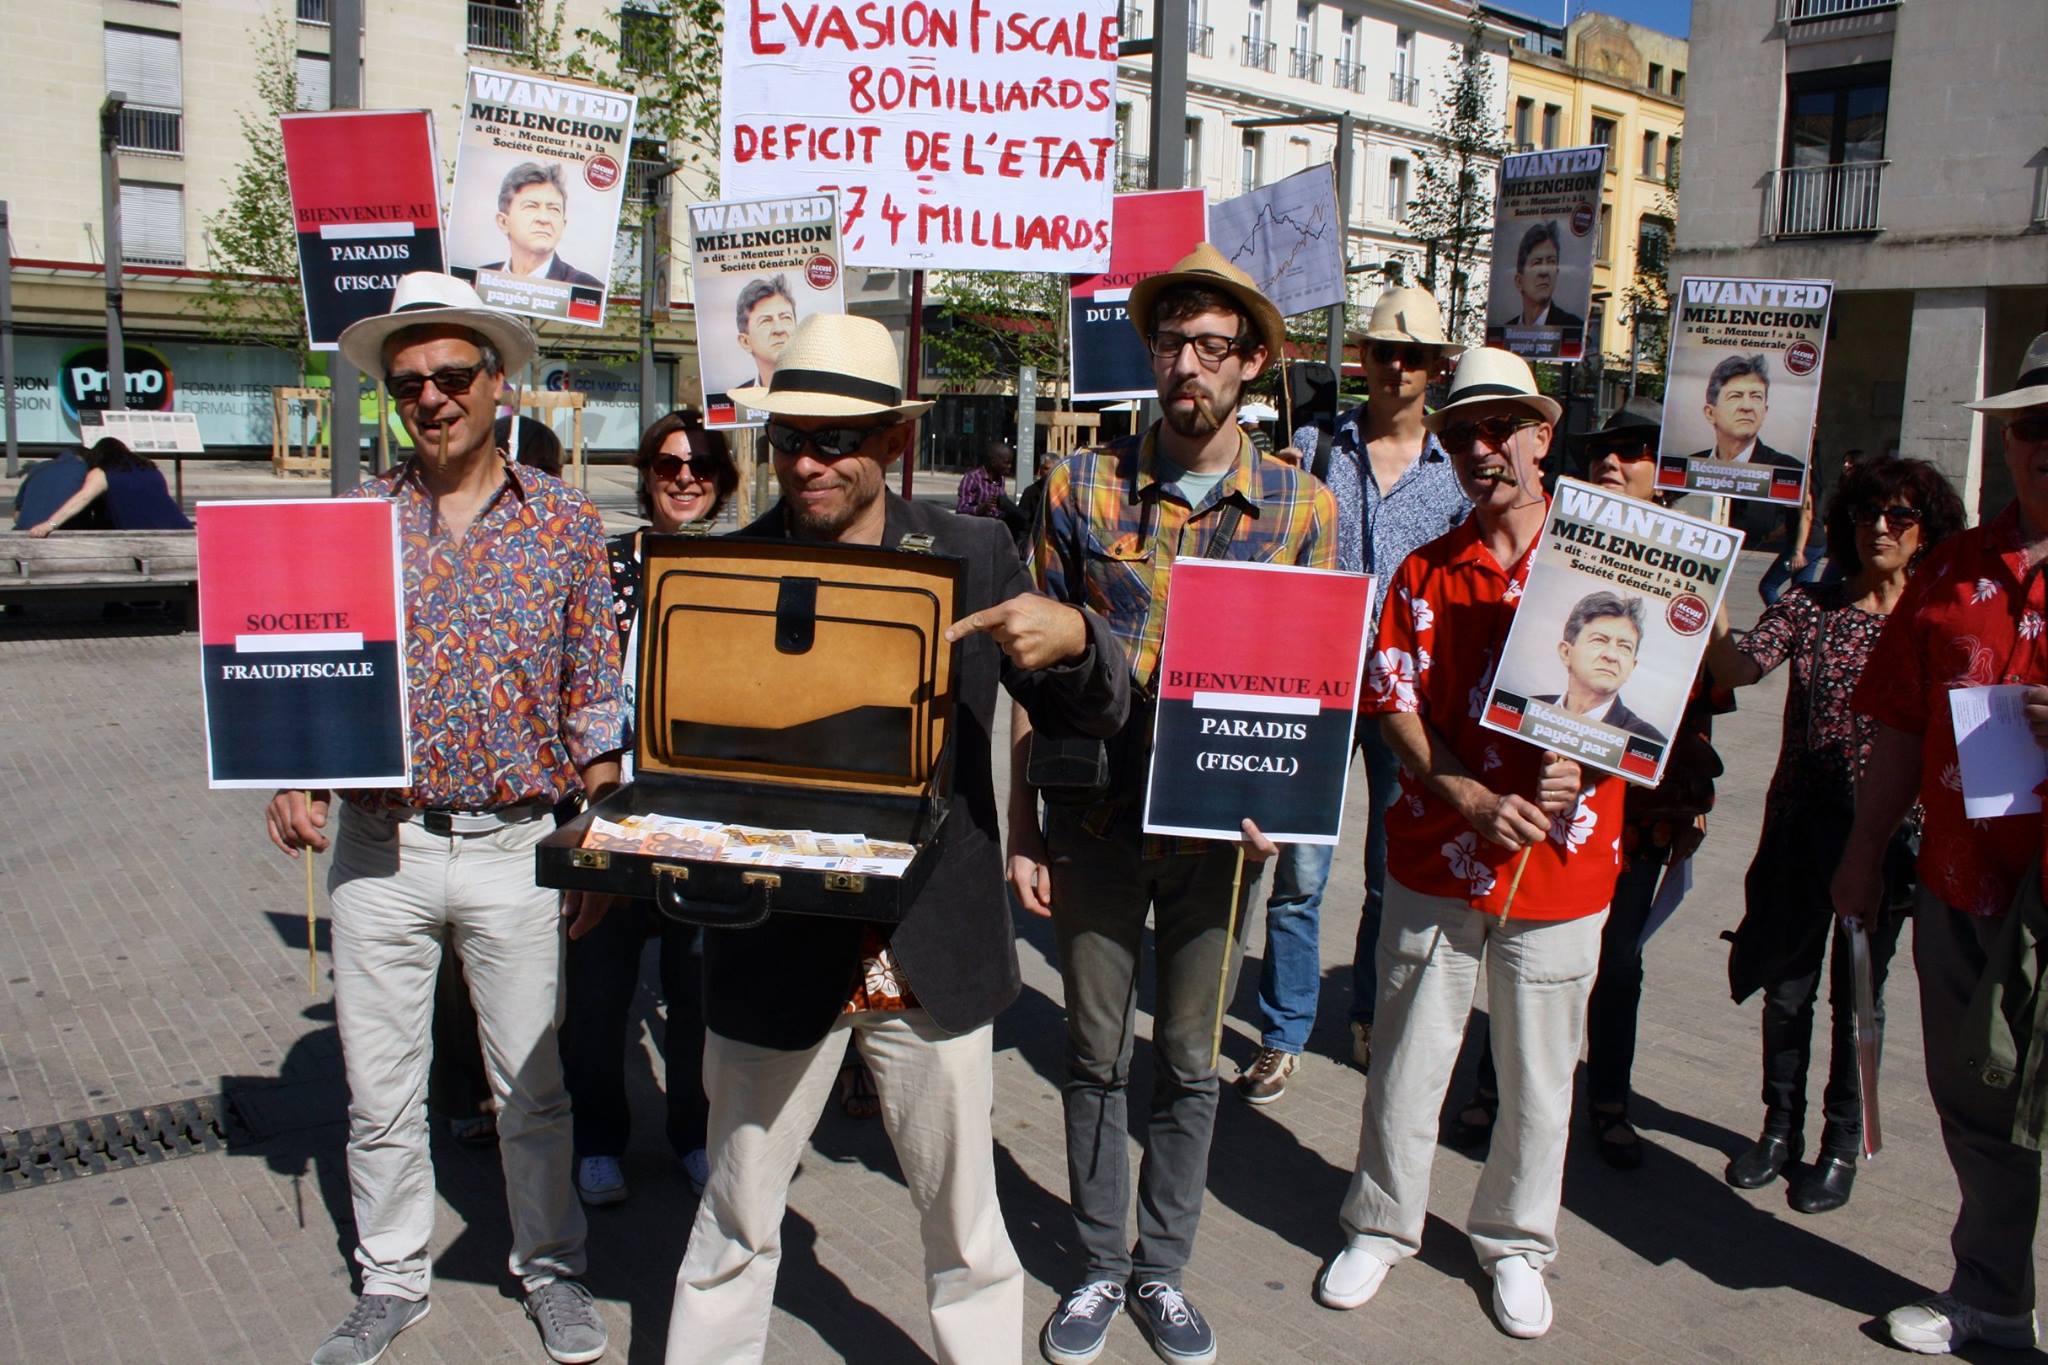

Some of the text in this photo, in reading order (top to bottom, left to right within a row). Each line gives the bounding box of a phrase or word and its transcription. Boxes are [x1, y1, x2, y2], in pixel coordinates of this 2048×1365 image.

[750, 0, 1120, 61] EVASION FISCALE
[474, 73, 628, 123] WANTED
[470, 103, 624, 144] MÉLENCHON
[475, 124, 482, 132] a
[485, 124, 501, 136] dit
[518, 130, 568, 147] Menteur
[595, 143, 605, 154] la
[493, 137, 586, 162] Société Générale
[734, 123, 1115, 181] DEFICIT DE L'ETAT
[1505, 149, 1602, 179] WANTED
[298, 203, 432, 222] BIENVENUE AU
[692, 197, 833, 232] WANTED
[817, 185, 1109, 253] 7,4 MILLIARDS
[330, 244, 410, 261] PARADIS
[695, 225, 832, 253] MÉLENCHON
[711, 253, 725, 263] dit
[741, 248, 785, 260] Menteur
[810, 245, 820, 254] la
[720, 257, 805, 273] Société Générale
[334, 273, 400, 293] (FISCA
[480, 271, 569, 298] Récompense
[1686, 281, 1828, 309] WANTED
[486, 289, 559, 310] payée par
[1086, 308, 1112, 322] DU
[1683, 305, 1823, 329] MÉLENCHON
[1695, 325, 1709, 334] dit
[1725, 327, 1769, 338] Menteur
[1796, 331, 1806, 340] la
[1702, 336, 1787, 349] Société Générale
[1688, 460, 1771, 481] Récompense
[1695, 474, 1761, 493] payée par
[1560, 486, 1732, 561] WANTED
[1550, 518, 1722, 585] MÉLENCHON
[1553, 542, 1562, 551] a
[1564, 544, 1582, 557] dit
[1599, 554, 1654, 580] Menteur
[1673, 577, 1682, 588] à
[1684, 581, 1697, 593] la
[1570, 558, 1672, 599] Société Générale
[247, 613, 350, 631] SOCIETE
[222, 662, 375, 680] FRAUDFISCALE
[1168, 670, 1350, 697] BIENVENUE AU
[1200, 717, 1307, 740] PARADIS
[1527, 702, 1626, 748] Récompense
[1532, 722, 1611, 758] payée par
[1196, 751, 1299, 776] (FISCAL)
